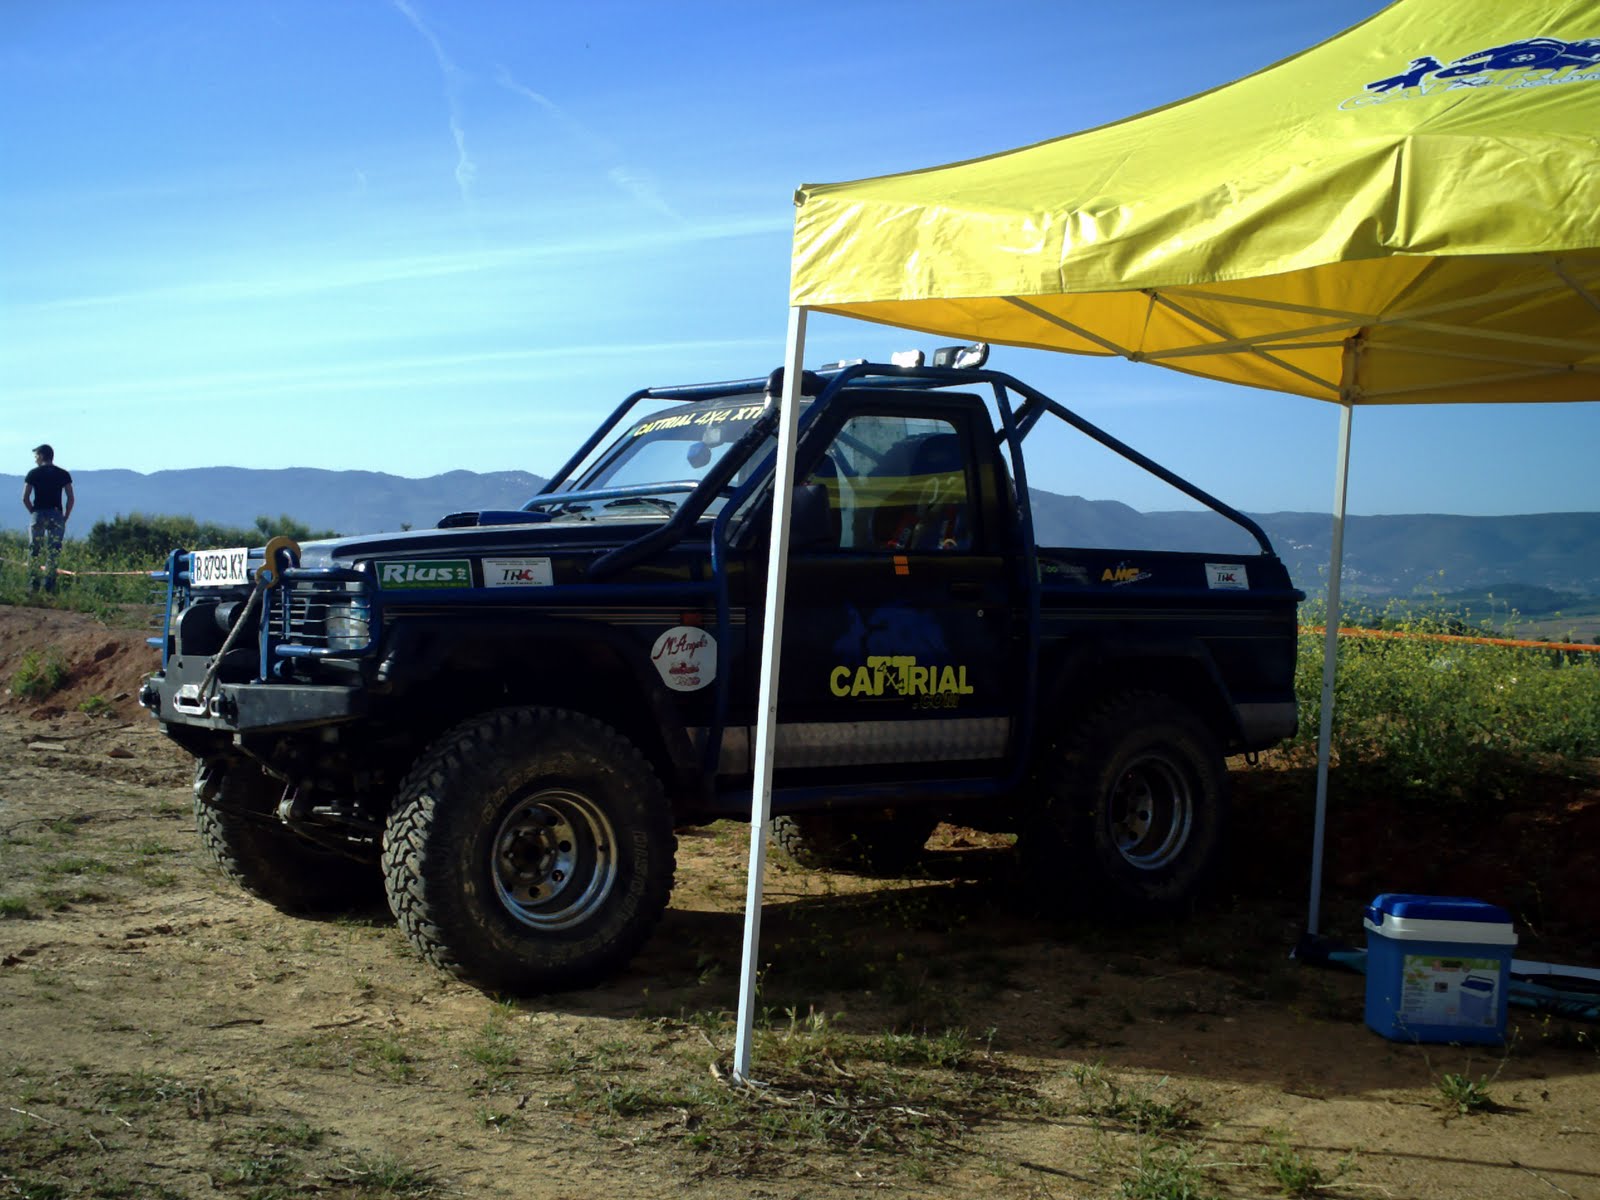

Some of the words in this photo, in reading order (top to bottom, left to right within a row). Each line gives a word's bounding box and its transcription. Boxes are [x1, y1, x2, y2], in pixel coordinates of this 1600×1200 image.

[633, 413, 697, 437] CATTRIAL
[204, 555, 227, 580] 8799
[382, 564, 454, 583] Rius
[829, 655, 975, 698] CATTRIAL
